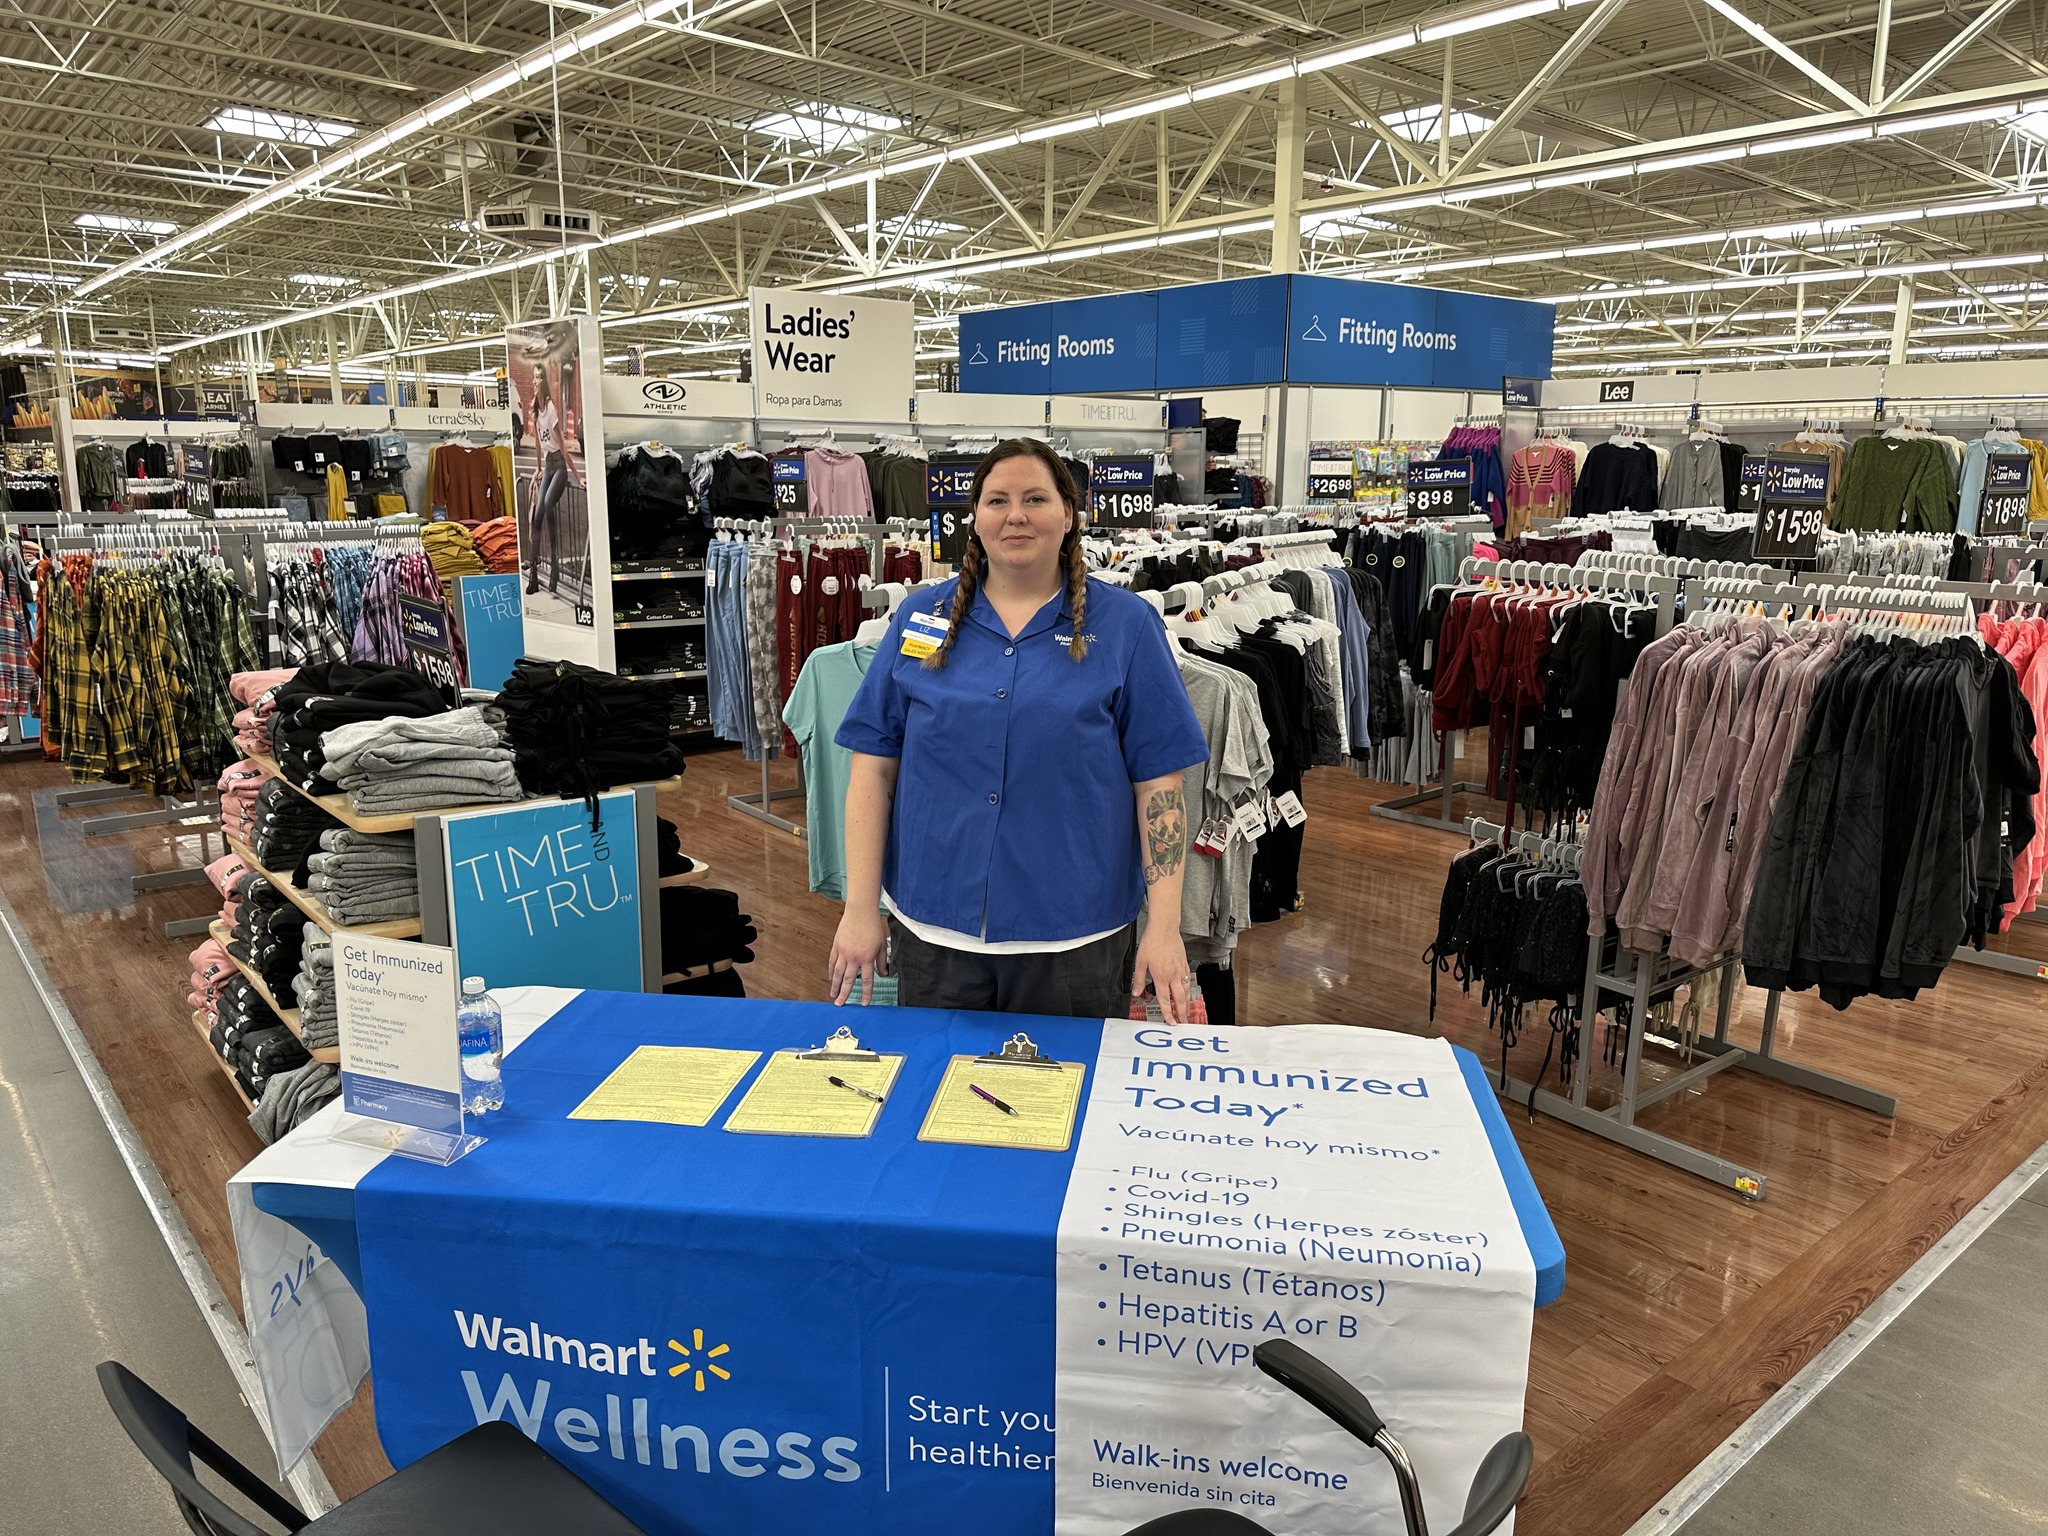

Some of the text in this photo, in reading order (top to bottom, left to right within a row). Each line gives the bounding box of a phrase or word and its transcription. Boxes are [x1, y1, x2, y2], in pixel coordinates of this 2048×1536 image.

[765, 303, 855, 339] Ladies'
[1339, 317, 1457, 354] Fitting Rooms
[764, 340, 836, 373] Wear
[998, 334, 1115, 366] Fitting Rooms
[766, 393, 843, 408] Ropa para Damas
[1604, 382, 1629, 400] Lee
[643, 403, 687, 411] ATHLETIC
[1081, 403, 1106, 420] TIME
[1112, 405, 1135, 421] TRU
[428, 411, 487, 429] terra&sky
[537, 427, 550, 442] Lee
[1108, 470, 1143, 480] Low Price
[1425, 471, 1443, 480] Low
[1444, 469, 1467, 479] Price
[1782, 473, 1824, 489] Low Price
[1784, 466, 1801, 474] Everyday
[1996, 469, 2021, 480] Low Price
[777, 484, 797, 504] $25
[465, 582, 519, 608] TIME AND
[482, 602, 521, 623] TRU
[577, 607, 592, 624] Lee
[412, 618, 425, 633] Low
[424, 621, 439, 637] Price
[919, 625, 931, 633] LIZ
[455, 824, 591, 901] TIME
[506, 865, 619, 936] TRU
[344, 946, 443, 975] Get Immunized
[383, 988, 398, 1000] hoy
[1134, 1029, 1230, 1053] Get
[374, 1060, 399, 1070] welcome
[1130, 1056, 1429, 1099] Immunized
[360, 1099, 388, 1112] Pharmacy
[1118, 1122, 1254, 1148] Vacúnate
[1265, 1136, 1319, 1155] hoy
[1131, 1165, 1279, 1190] Flu (Gripe)
[1127, 1184, 1250, 1206] Covid-19
[1123, 1203, 1489, 1248] Shingles (Herpes zóster)
[1121, 1222, 1482, 1277] Pneumonia (Neumonía)
[1117, 1254, 1386, 1307] Tetanus (Tétanos)
[1118, 1292, 1358, 1339] Hepatitis A or B
[453, 1309, 656, 1376] Walmart
[1118, 1330, 1257, 1367] HPV (VP
[908, 1395, 990, 1427] Start
[460, 1370, 861, 1483] Wellness
[1093, 1439, 1348, 1491] Walk-ins welcome
[1092, 1472, 1276, 1507] Bienvenida sin cita
